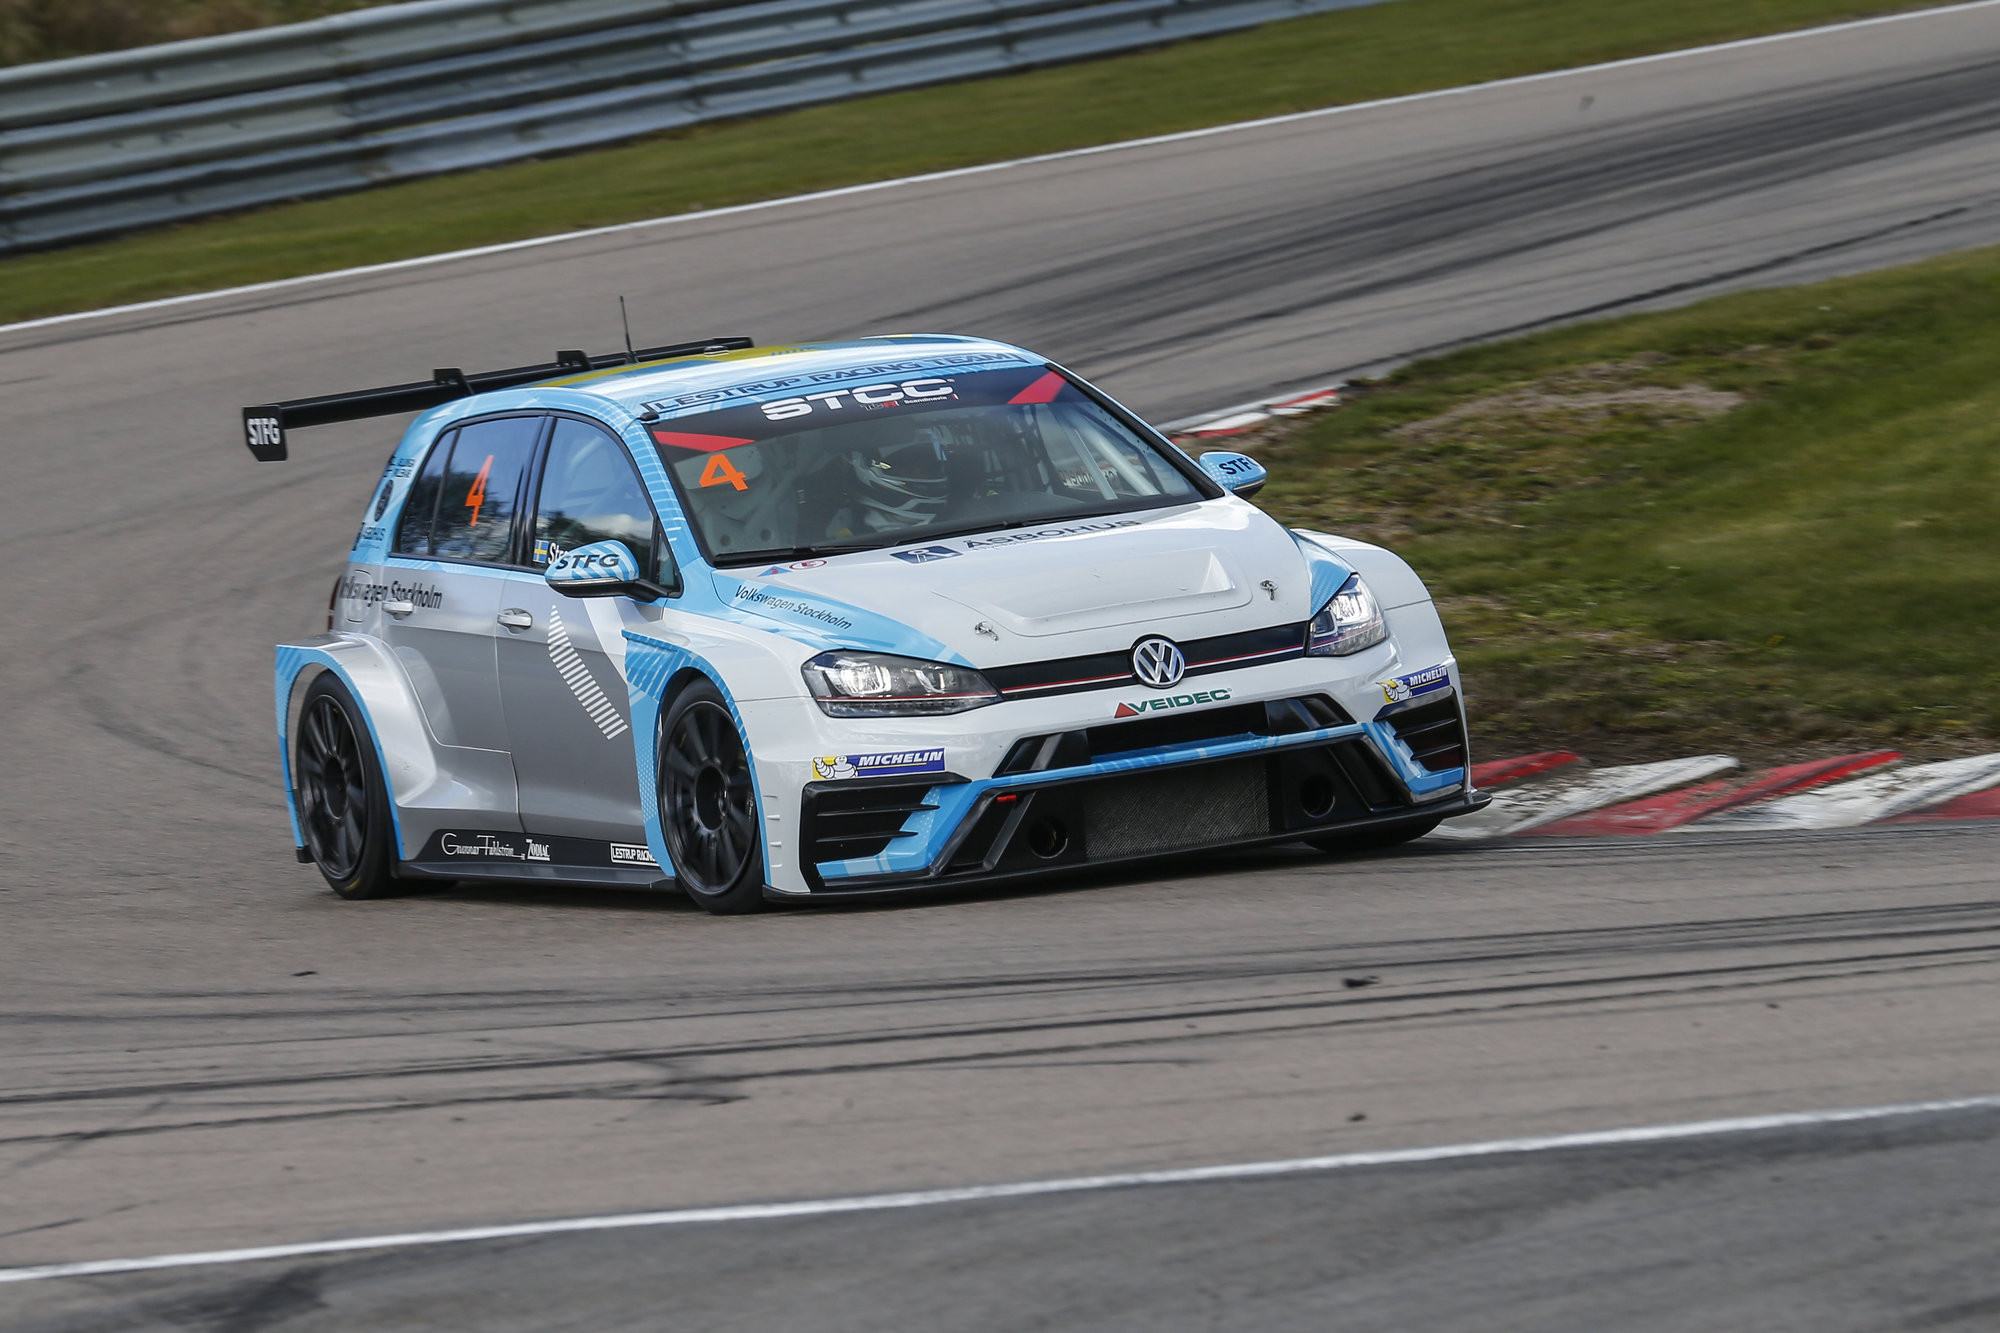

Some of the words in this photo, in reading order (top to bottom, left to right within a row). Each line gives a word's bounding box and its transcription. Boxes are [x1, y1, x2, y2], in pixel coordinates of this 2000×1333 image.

[653, 378, 801, 412] LESTRUP
[809, 361, 922, 383] RACING
[924, 352, 1010, 366] TEAM
[761, 379, 954, 421] STCC
[903, 396, 948, 405] Scandinavia
[247, 418, 281, 446] STFG
[699, 454, 748, 492] 4
[1218, 457, 1259, 475] STF
[464, 454, 495, 527] 4
[555, 553, 620, 570] STFG
[735, 585, 796, 610] Volkswagen
[793, 603, 853, 629] Stockholm
[1409, 666, 1447, 686] MICHELIN
[1133, 688, 1230, 713] VEIDEC
[858, 750, 944, 767] MICHELIN
[612, 847, 636, 860] LESTRUP
